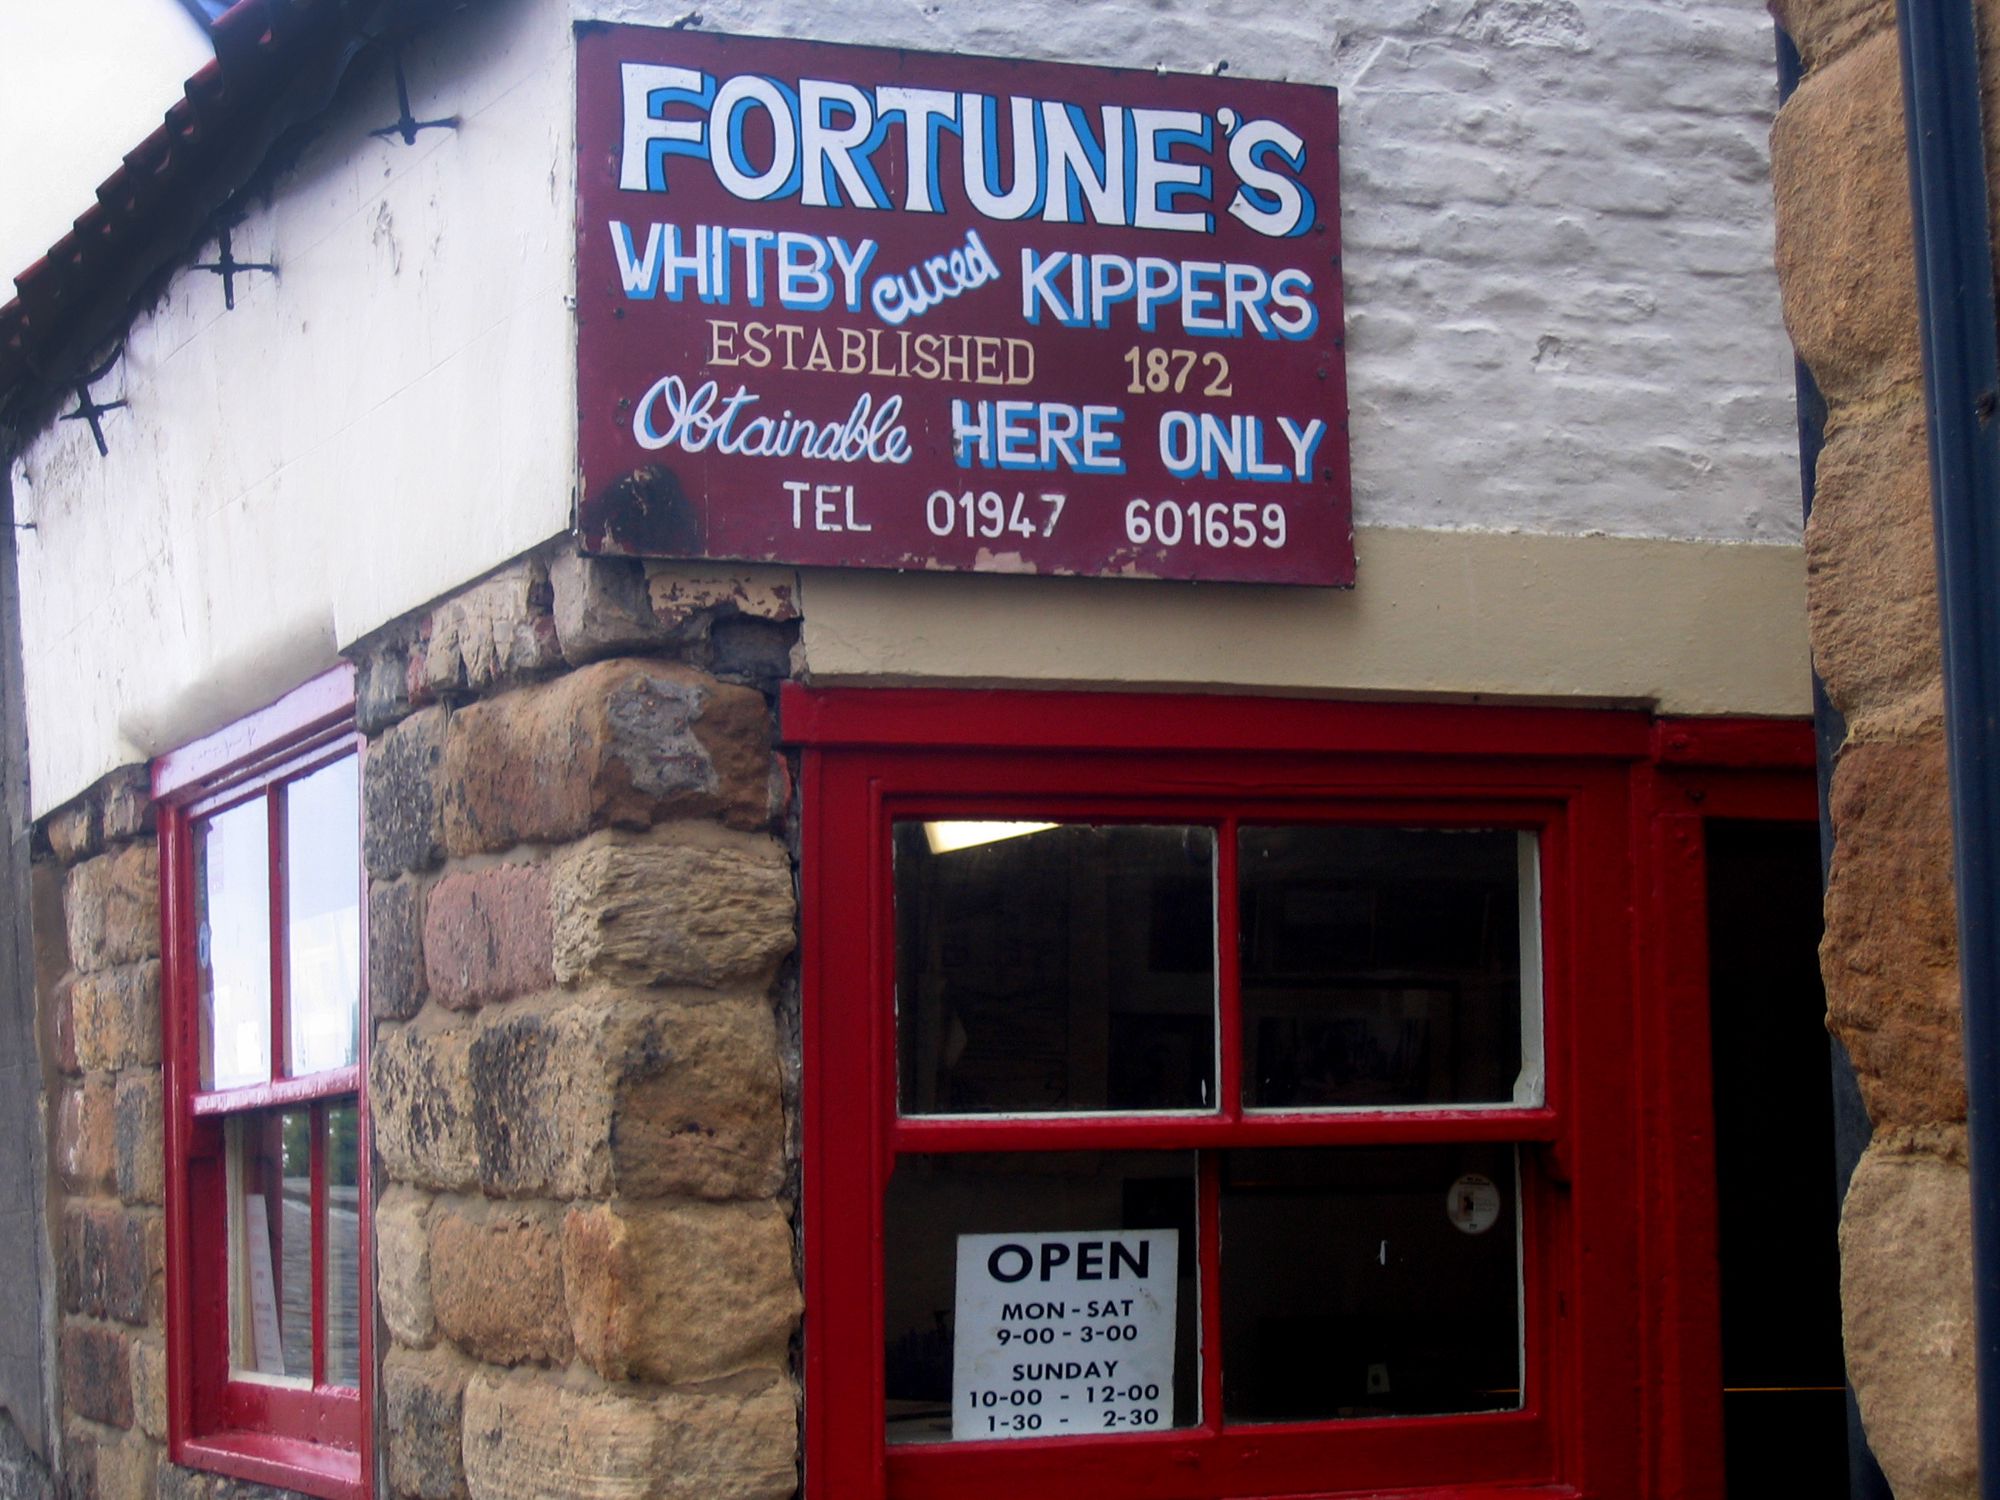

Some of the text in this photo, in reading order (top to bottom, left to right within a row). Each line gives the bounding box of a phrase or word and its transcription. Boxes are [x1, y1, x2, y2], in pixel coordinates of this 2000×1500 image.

[619, 62, 1317, 239] FORTUNE'S
[608, 219, 1319, 341] WHITBY cured KIPPERS
[705, 318, 1233, 397] ESTABLISHED 1872
[632, 374, 1327, 483] Obtainable HERE ONLY
[782, 480, 1287, 549] TEL 01947 601659
[987, 1240, 1149, 1283] OPEN
[969, 1389, 1043, 1408] 10-00
[1086, 1384, 1160, 1404] 12-00
[1012, 1360, 1119, 1381] SUNDAY
[987, 1414, 1043, 1432] 1-30
[1102, 1408, 1159, 1428] 2-30
